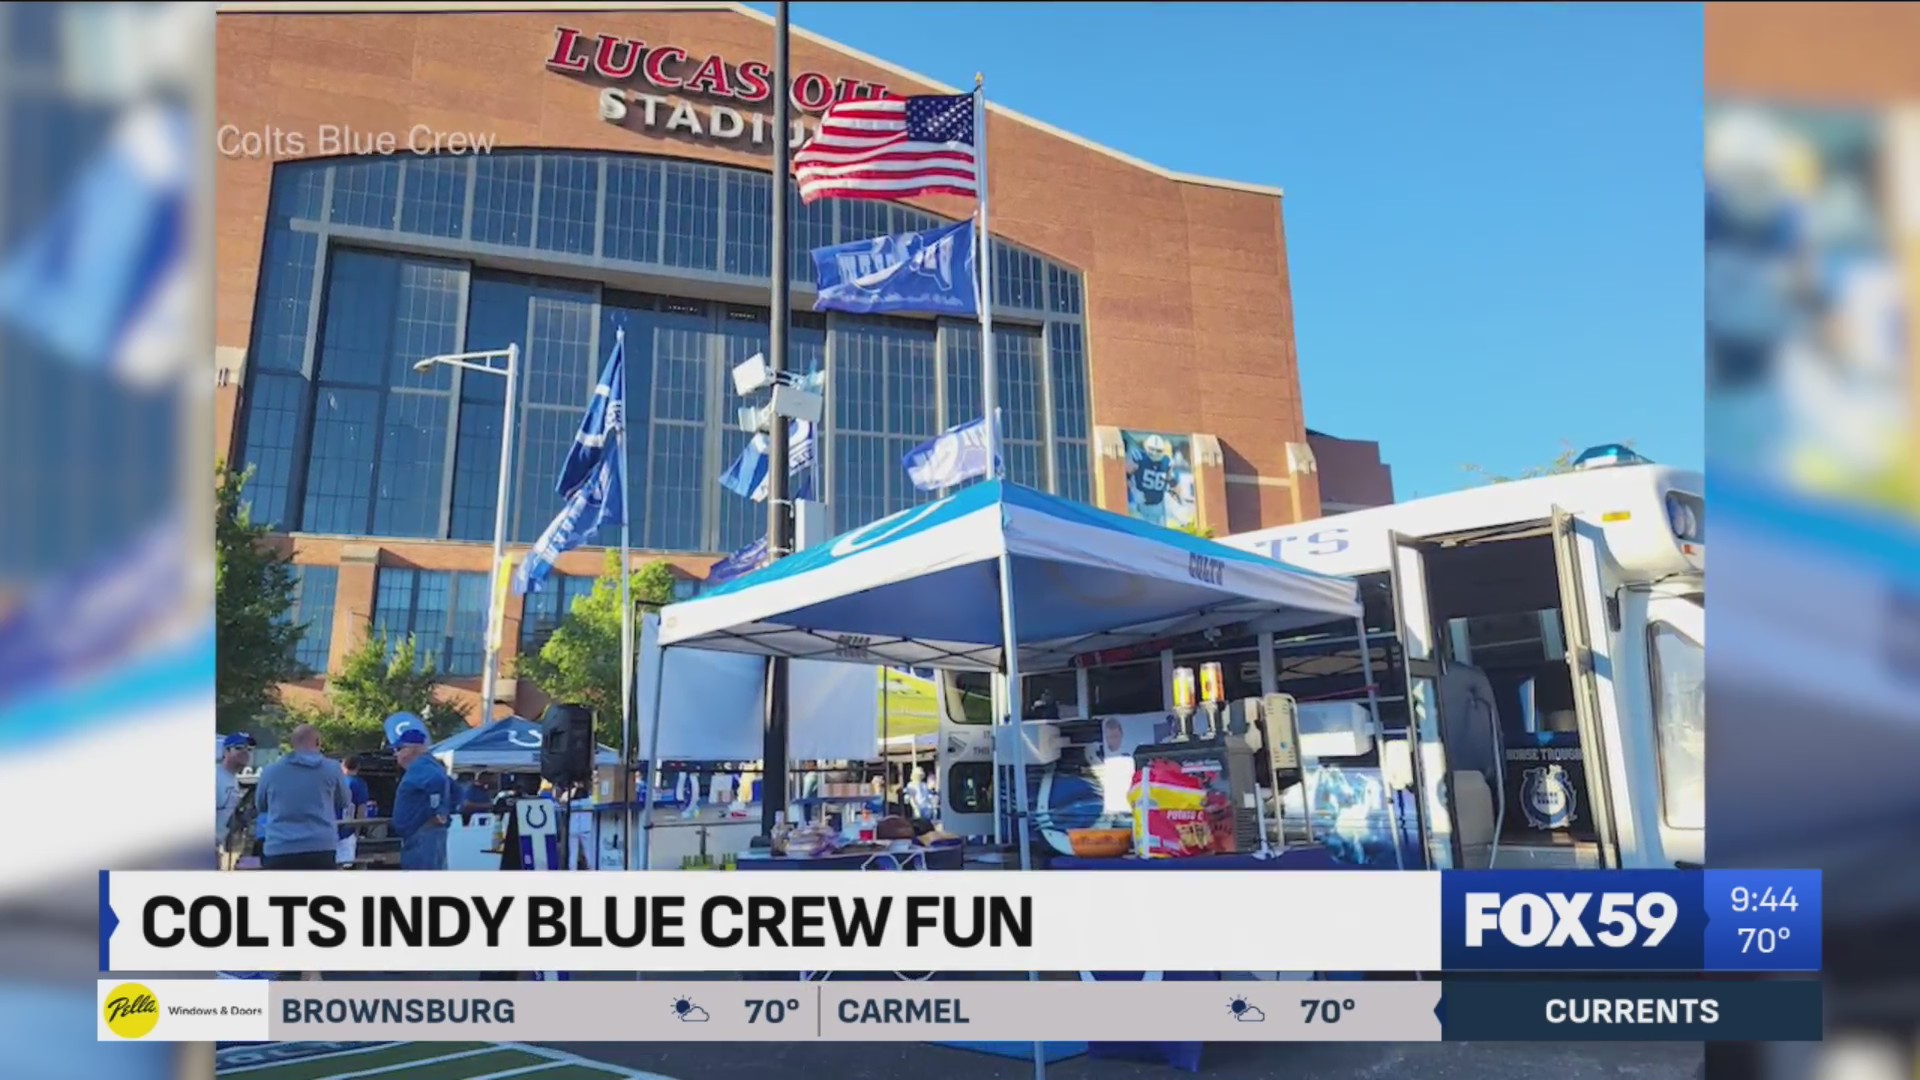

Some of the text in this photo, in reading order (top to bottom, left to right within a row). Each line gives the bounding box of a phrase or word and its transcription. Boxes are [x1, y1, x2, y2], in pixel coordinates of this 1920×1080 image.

[546, 26, 770, 101] LUCAS
[1141, 468, 1167, 491] 56
[1188, 551, 1225, 586] COLTS
